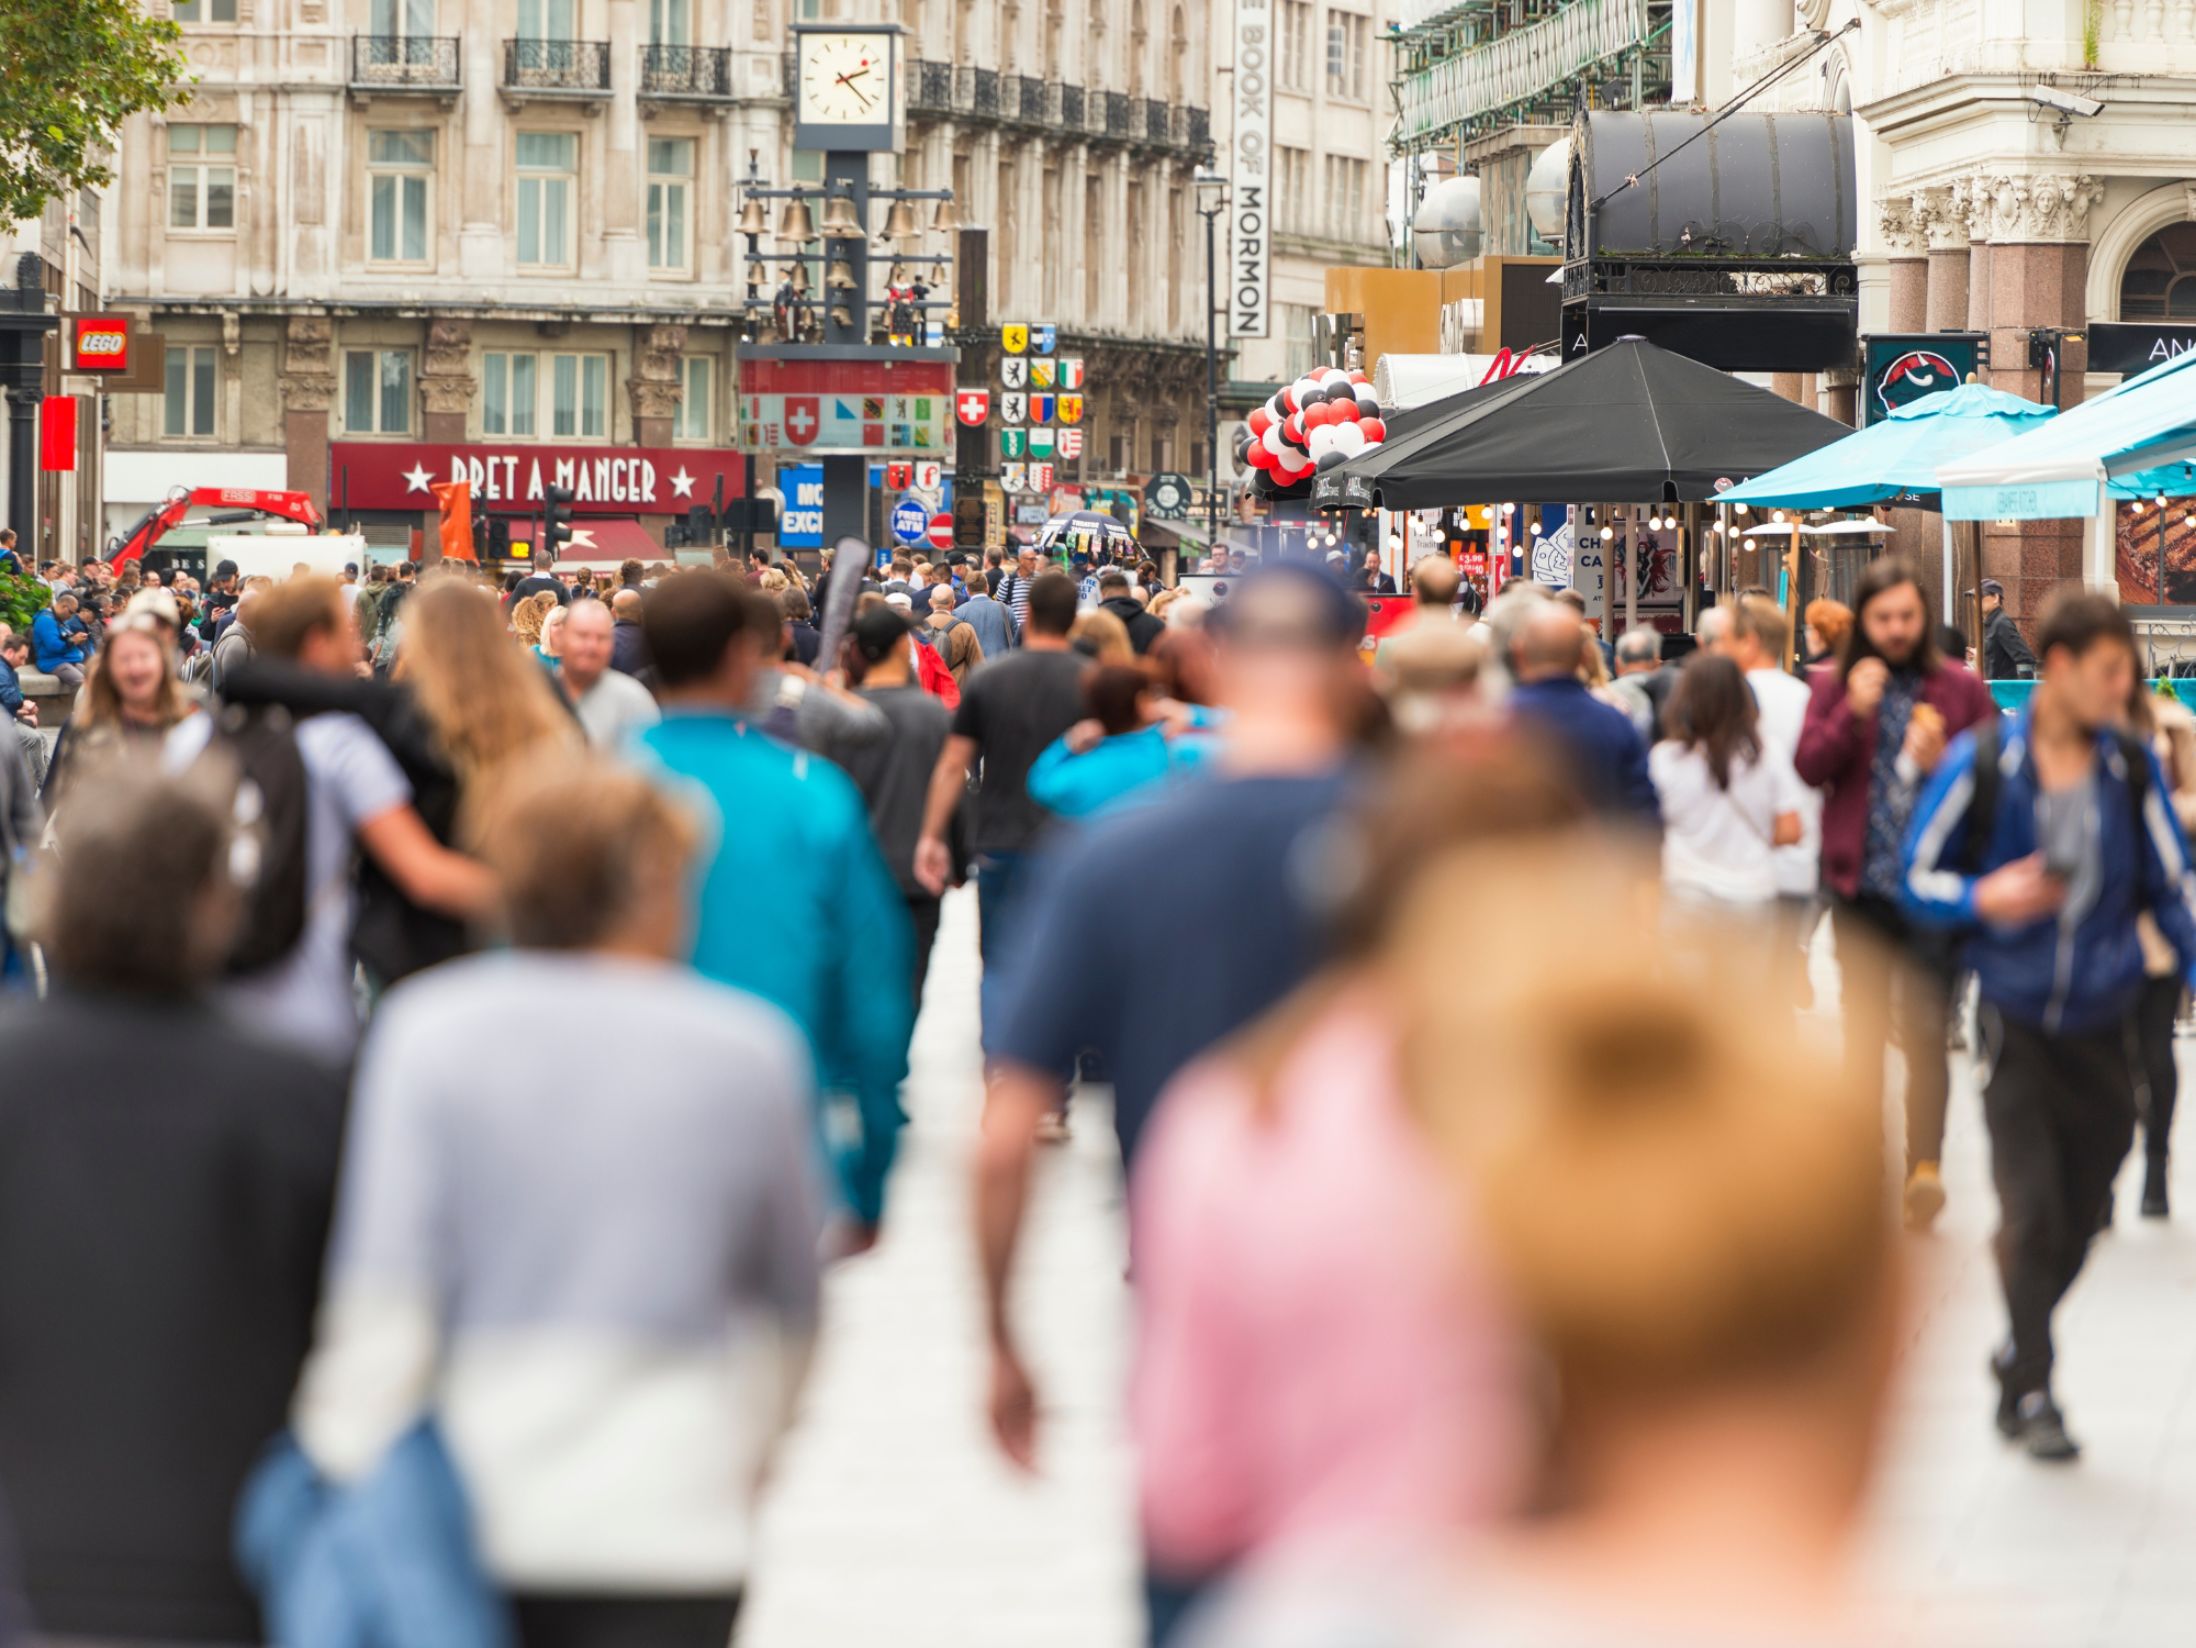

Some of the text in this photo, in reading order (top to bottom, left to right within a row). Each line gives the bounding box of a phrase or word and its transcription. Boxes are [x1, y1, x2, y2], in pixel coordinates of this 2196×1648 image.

[1241, 24, 1264, 118] BOOK
[1240, 131, 1263, 175] OF
[1238, 187, 1261, 332] MORMON
[80, 333, 124, 353] LEGO
[451, 454, 657, 503] PRET A MANGER
[783, 511, 824, 533] EXC
[897, 510, 923, 521] FREE
[897, 520, 923, 532] ATM
[1579, 537, 1603, 549] CH
